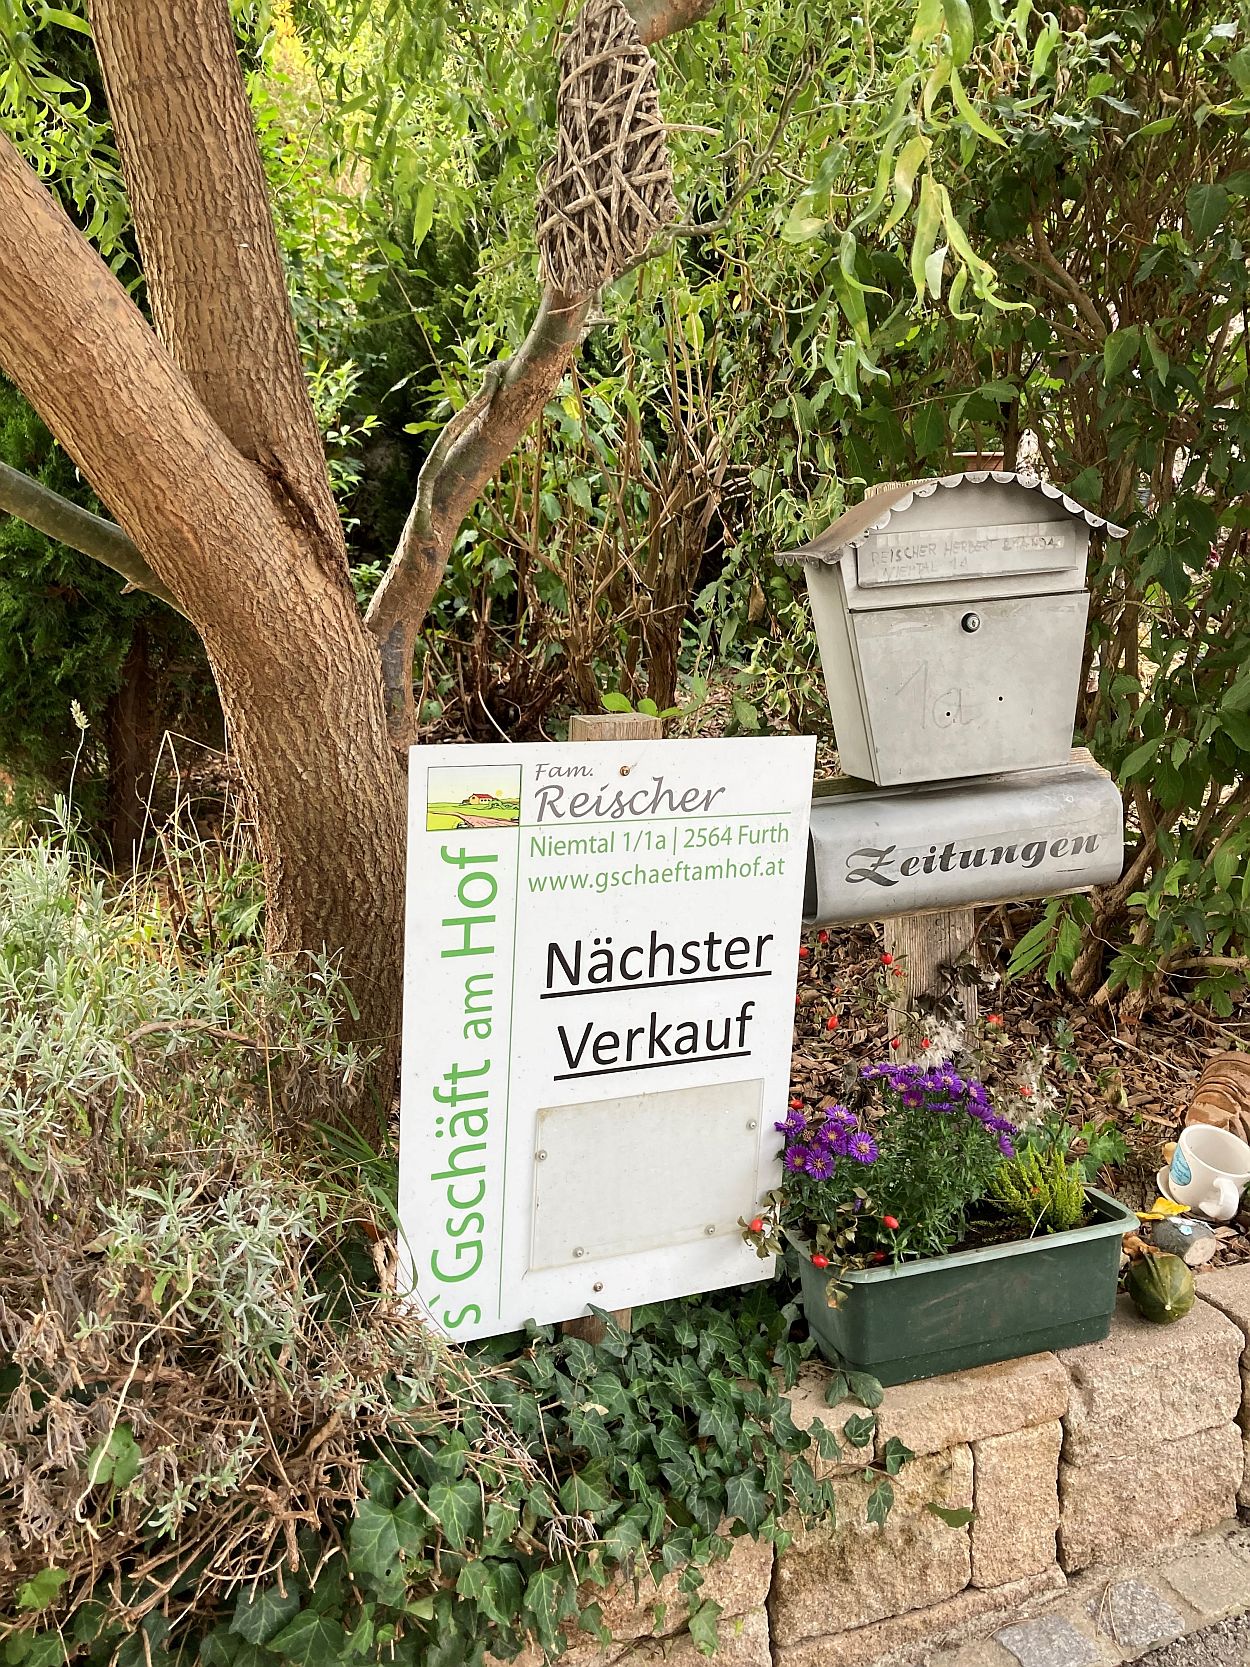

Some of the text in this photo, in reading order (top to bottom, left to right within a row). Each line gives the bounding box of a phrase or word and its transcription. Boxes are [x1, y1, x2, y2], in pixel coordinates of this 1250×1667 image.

[871, 543, 937, 567] REISCHER
[534, 776, 726, 822] Reischer
[535, 763, 594, 781] Fam.
[530, 831, 615, 857] Niemtal
[622, 829, 667, 854] 1/1a
[683, 826, 733, 849] 2564
[738, 822, 789, 846] Furth
[845, 833, 1100, 887] Zeitungen
[528, 855, 785, 893] www.gschaeftamhof.at
[440, 845, 499, 958] Hof
[545, 930, 774, 989] Nächster
[463, 972, 494, 1040] am
[557, 1001, 756, 1070] Verkauf
[430, 1058, 491, 1285] Gschäft
